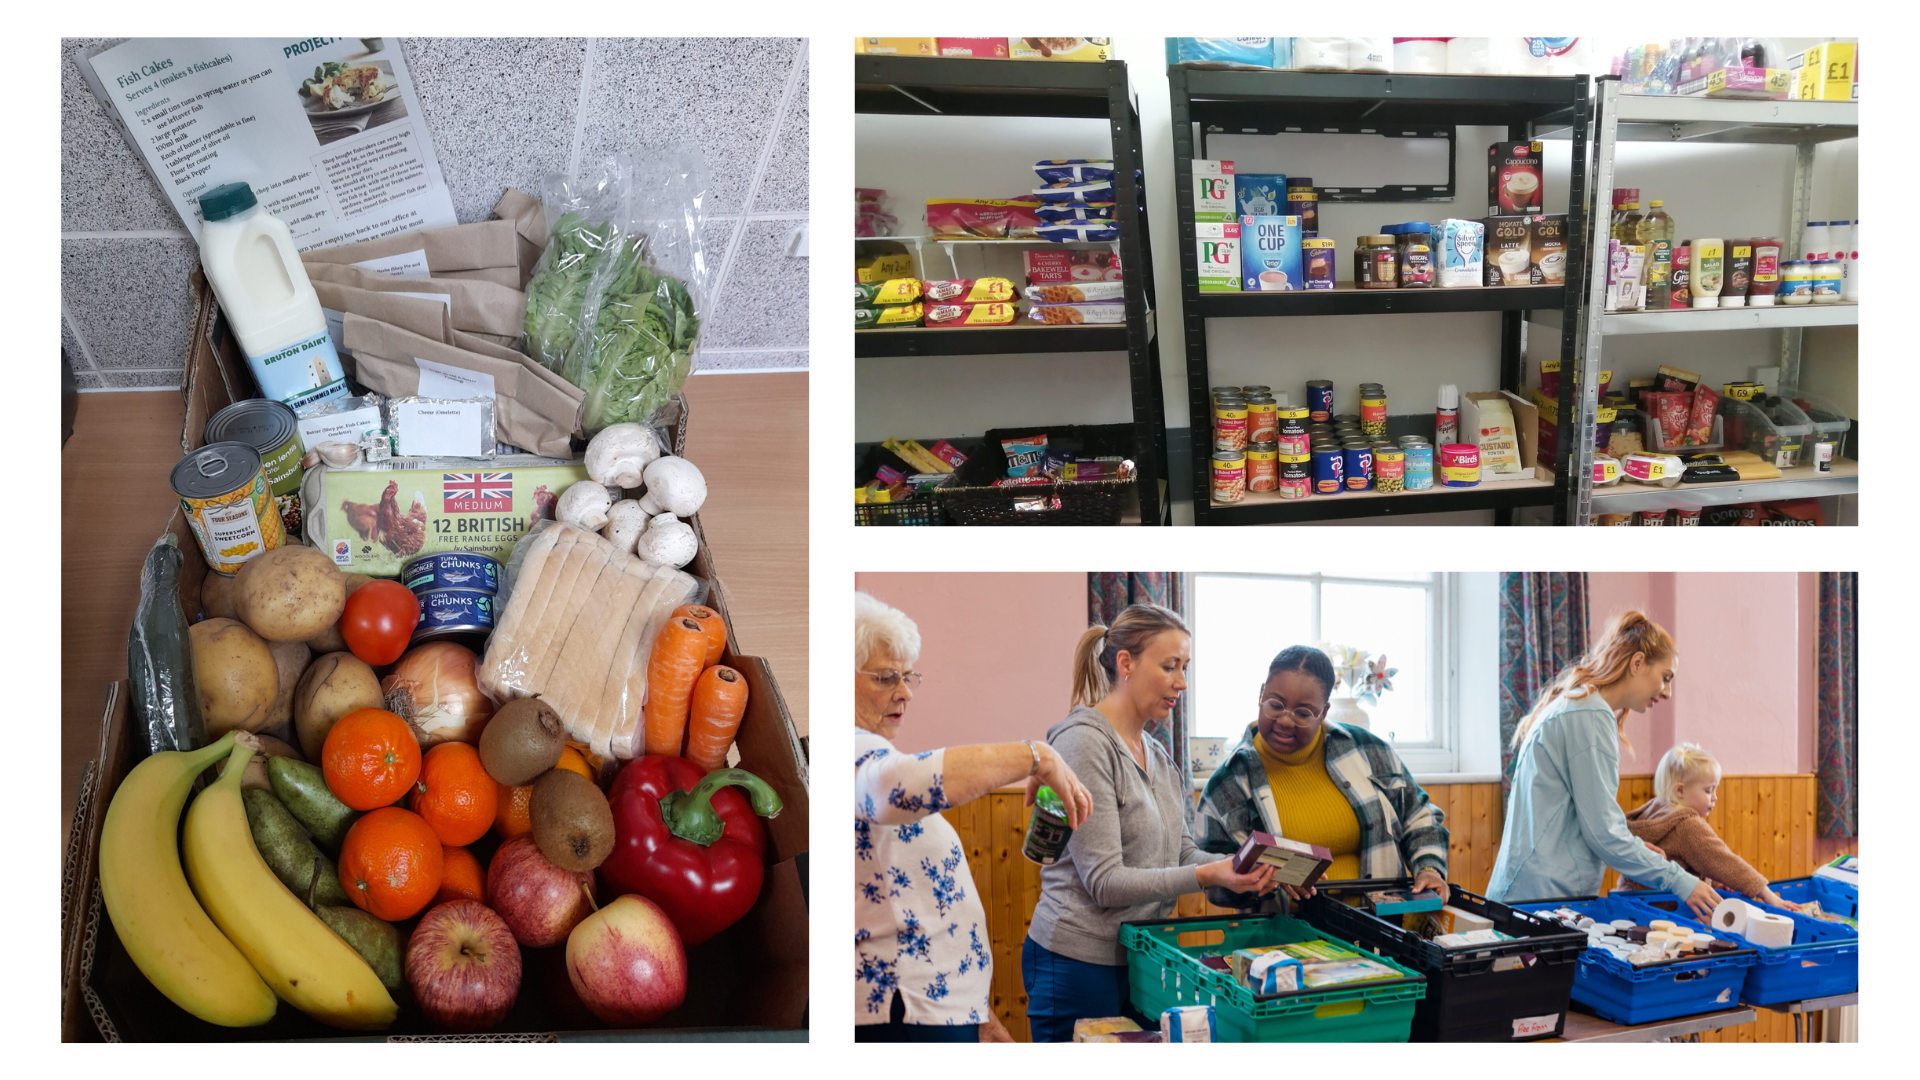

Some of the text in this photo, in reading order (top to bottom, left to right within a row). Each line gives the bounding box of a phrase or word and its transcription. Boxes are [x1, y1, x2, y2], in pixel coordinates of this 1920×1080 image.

[1809, 50, 1820, 66] £1
[116, 58, 173, 88] Fish Cakes
[126, 86, 153, 102] Serves
[160, 71, 187, 87] (makes
[194, 54, 232, 72] fishcakes)
[1828, 63, 1849, 79] £1
[152, 108, 168, 120] small
[168, 104, 180, 112] tins
[181, 98, 195, 106] tuna
[203, 87, 223, 98] spring
[223, 82, 239, 90] water
[248, 74, 260, 83] you
[135, 97, 171, 117] Ingredients
[167, 110, 190, 124] leftover
[191, 104, 203, 112] fish
[155, 131, 171, 141] large
[172, 119, 196, 135] potatoes
[156, 133, 188, 152] 100ml milk
[161, 150, 176, 161] Knob
[183, 137, 202, 149] butter
[203, 123, 235, 140] (spreadable
[242, 115, 256, 123] fine)
[170, 149, 200, 167] tablespoon
[208, 139, 221, 148] olive
[170, 167, 185, 177] Flour
[196, 151, 218, 164] coating
[1505, 158, 1538, 166] Cappuccino
[175, 165, 210, 185] Black Pepper
[182, 182, 206, 197] Optional
[1200, 178, 1226, 200] PG
[310, 242, 323, 252] your
[325, 236, 343, 244] empty
[356, 226, 371, 234] back
[392, 214, 408, 222] office
[1258, 224, 1284, 237] ONE
[1496, 228, 1525, 237] GOLD
[1258, 238, 1285, 251] CUP
[1456, 240, 1476, 249] Spoon
[1203, 242, 1230, 264] PG
[881, 261, 899, 275] Any 2
[898, 284, 912, 295] £1
[988, 282, 1003, 293] £1
[988, 303, 1003, 315] £1
[264, 336, 326, 366] BRUTON DAIRY
[294, 385, 342, 409] SEMI SKIMMED MILK
[278, 444, 297, 462] lentils
[1480, 442, 1510, 451] CUSTARD
[1459, 455, 1477, 464] Bird's
[1653, 466, 1663, 474] £1
[454, 501, 503, 510] MEDIUM
[226, 510, 248, 521] SEASONS
[215, 526, 251, 536] SUPERSWEET
[433, 518, 524, 533] 12 BRITISH
[215, 530, 255, 541] SWEETCORN
[464, 544, 503, 553] Sainsbury's
[441, 561, 481, 570] CHUNKS
[431, 598, 472, 606] CHUNKS
